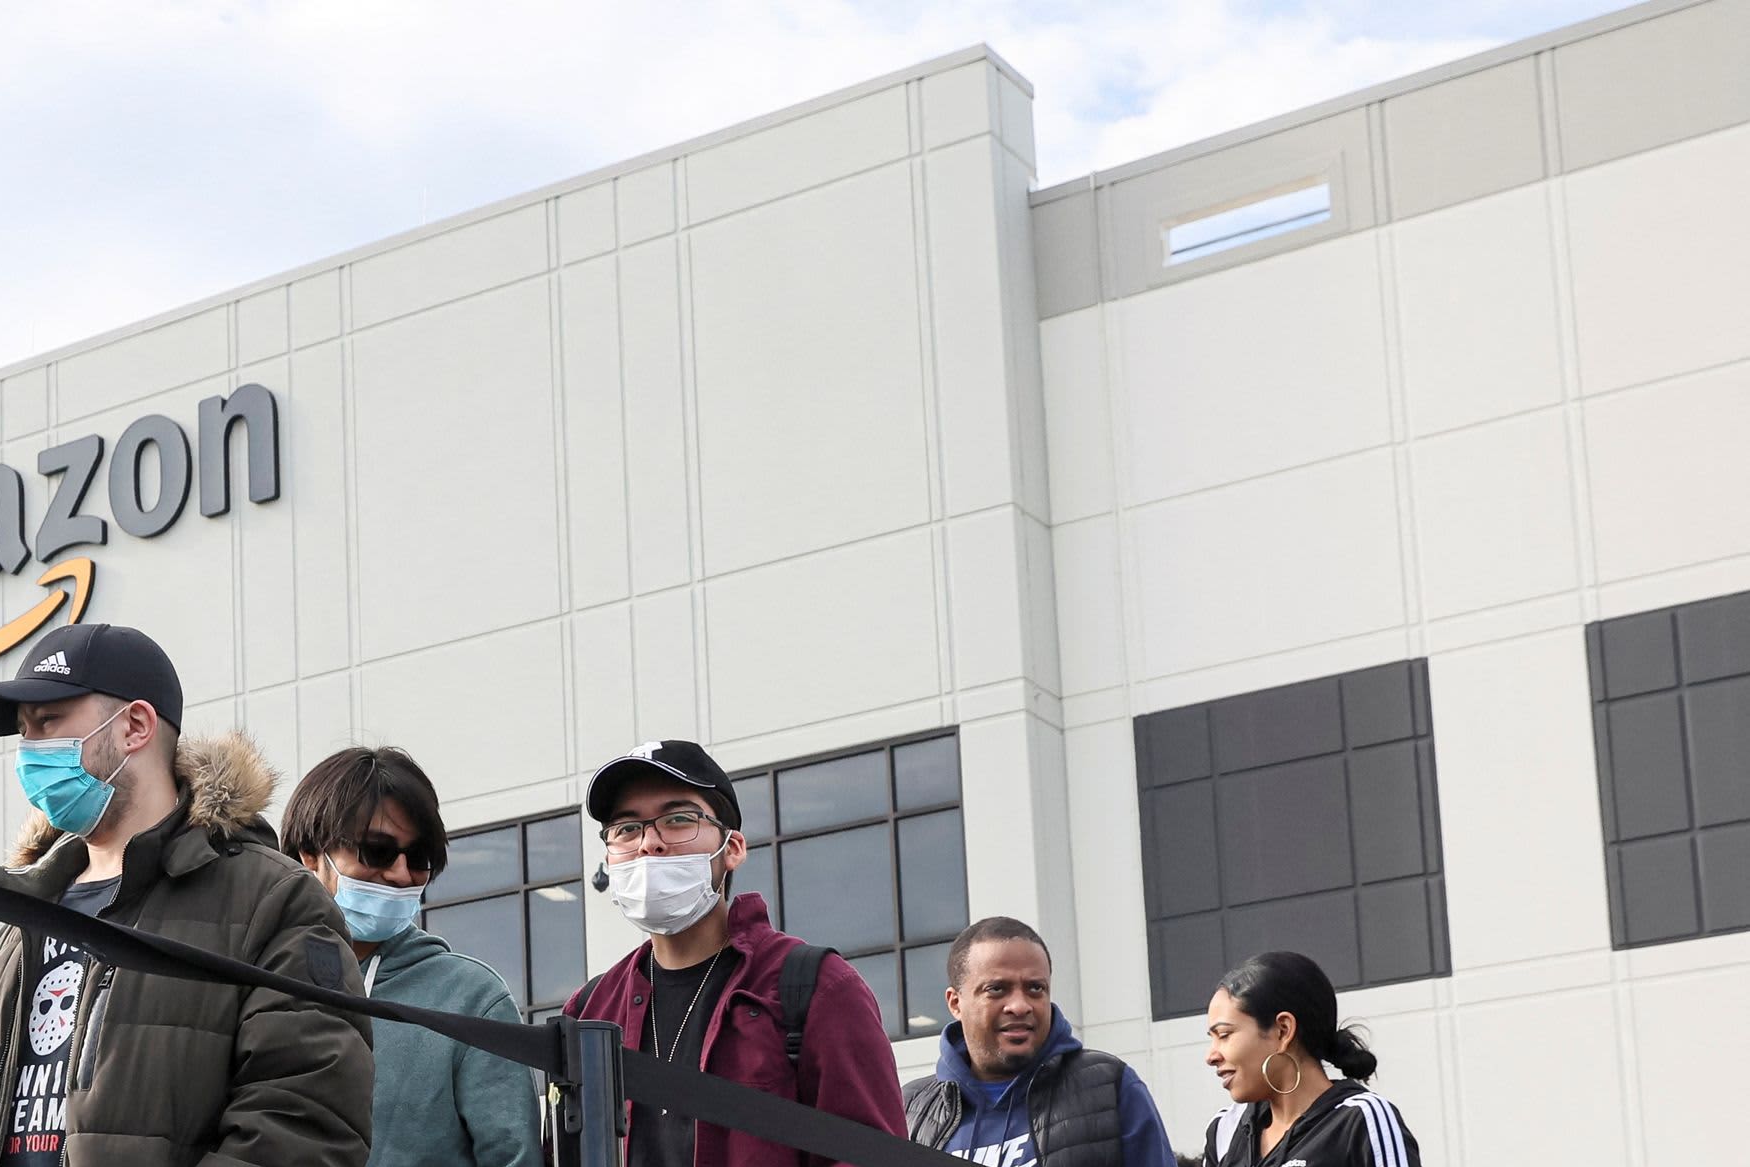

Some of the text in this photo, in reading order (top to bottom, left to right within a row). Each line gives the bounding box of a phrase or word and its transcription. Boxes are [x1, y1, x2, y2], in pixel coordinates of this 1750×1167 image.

[33, 663, 71, 675] adidas
[11, 1097, 67, 1133] EAM
[25, 1134, 59, 1152] YOUR
